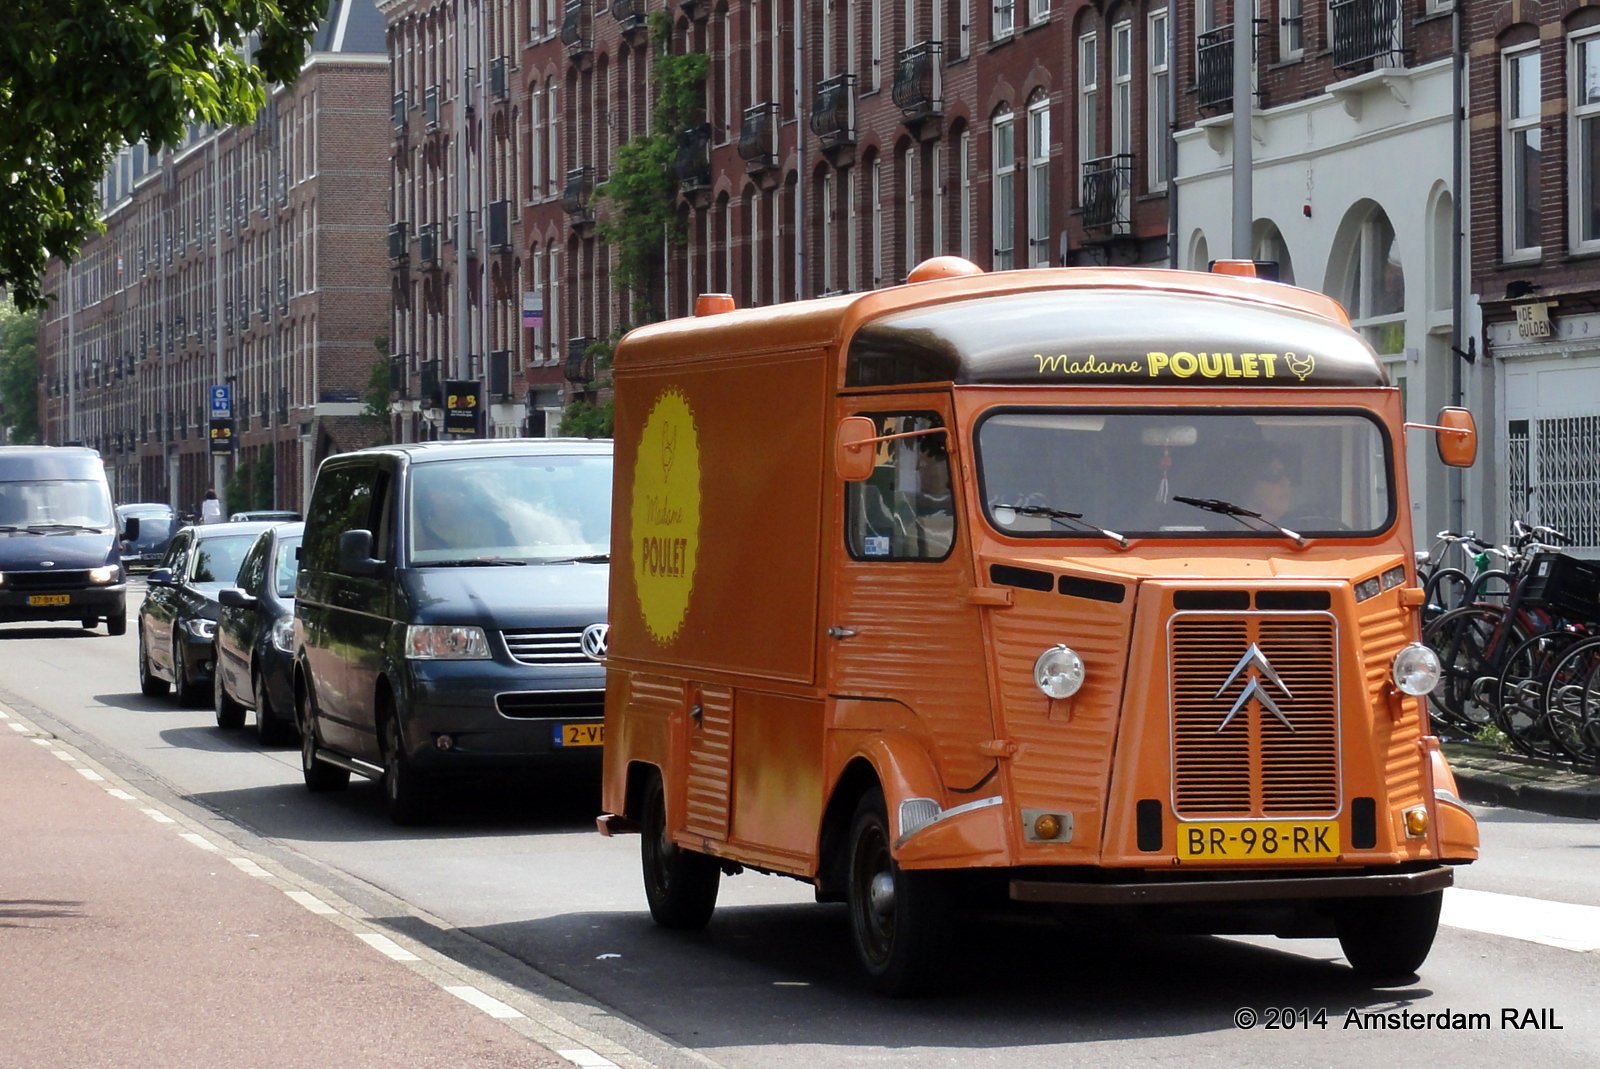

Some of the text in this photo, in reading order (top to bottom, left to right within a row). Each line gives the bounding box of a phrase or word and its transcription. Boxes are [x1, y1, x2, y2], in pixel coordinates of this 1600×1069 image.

[1521, 306, 1533, 321] DE
[1518, 320, 1550, 338] GULDEN
[1034, 351, 1278, 378] Madame POULET
[646, 496, 684, 527] Madame
[641, 536, 688, 578] POULET
[1187, 826, 1332, 855] BR-98-RK
